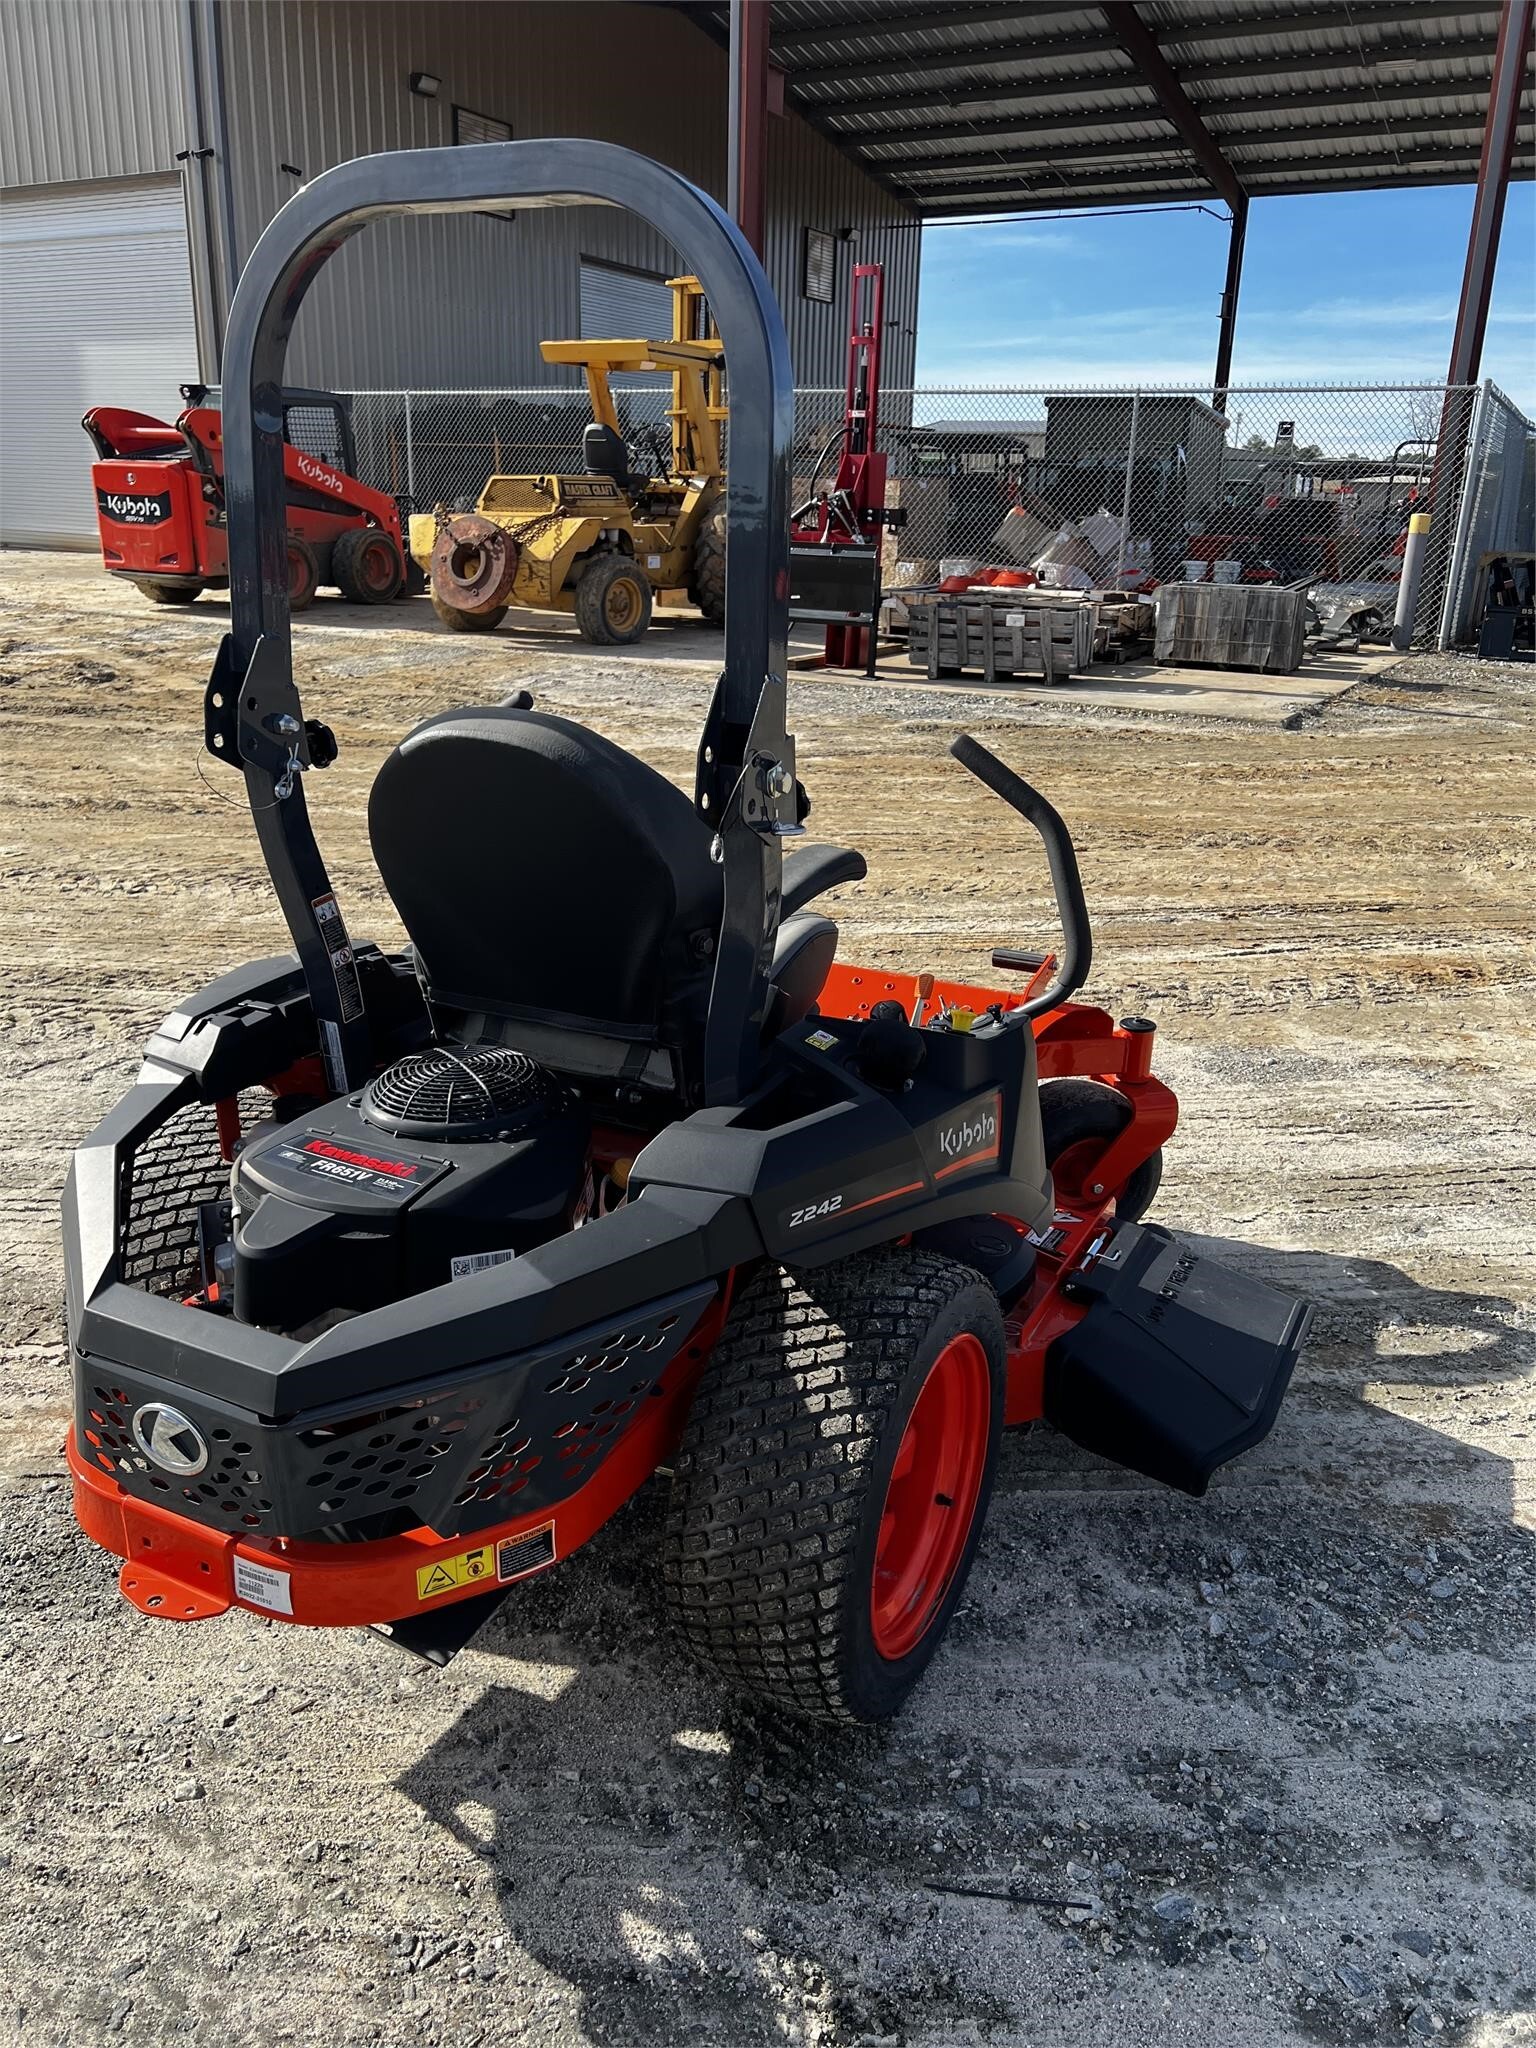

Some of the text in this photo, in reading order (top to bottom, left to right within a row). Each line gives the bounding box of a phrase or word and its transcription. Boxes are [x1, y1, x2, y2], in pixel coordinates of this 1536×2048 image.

[297, 455, 344, 494] Kubota
[592, 484, 614, 496] CRAFT
[107, 495, 161, 516] Kubota
[939, 1112, 995, 1156] Kubota
[304, 1139, 418, 1178] Kawasaki
[310, 1158, 373, 1183] FR651V
[789, 1194, 843, 1228] Z242
[512, 1526, 547, 1545] WARNING
